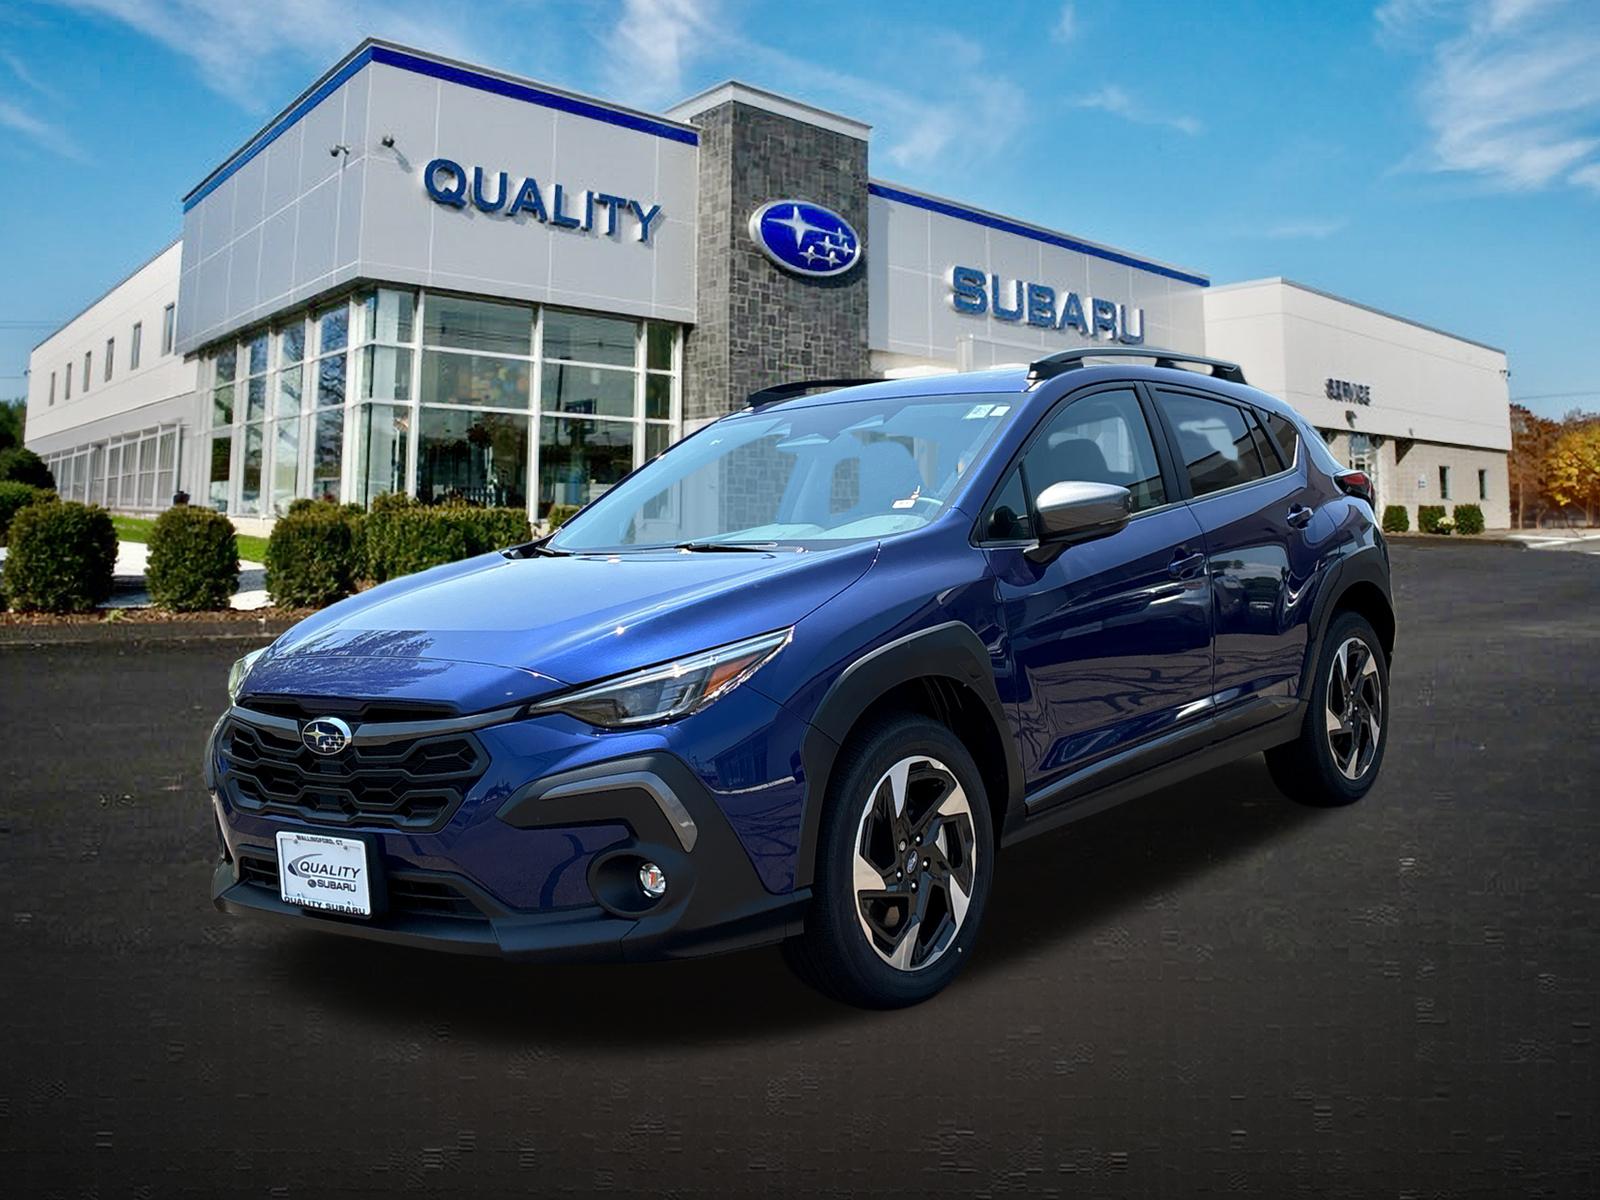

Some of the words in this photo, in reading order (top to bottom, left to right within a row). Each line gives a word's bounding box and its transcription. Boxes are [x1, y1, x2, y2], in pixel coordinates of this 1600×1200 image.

[424, 158, 661, 242] QUALITY
[950, 265, 1144, 345] SUBARU
[1324, 378, 1370, 406] SERVICE
[300, 861, 361, 879] QUALITY
[317, 879, 356, 893] SUBARU
[284, 896, 322, 909] QUALITY
[325, 903, 366, 915] SUBARU
